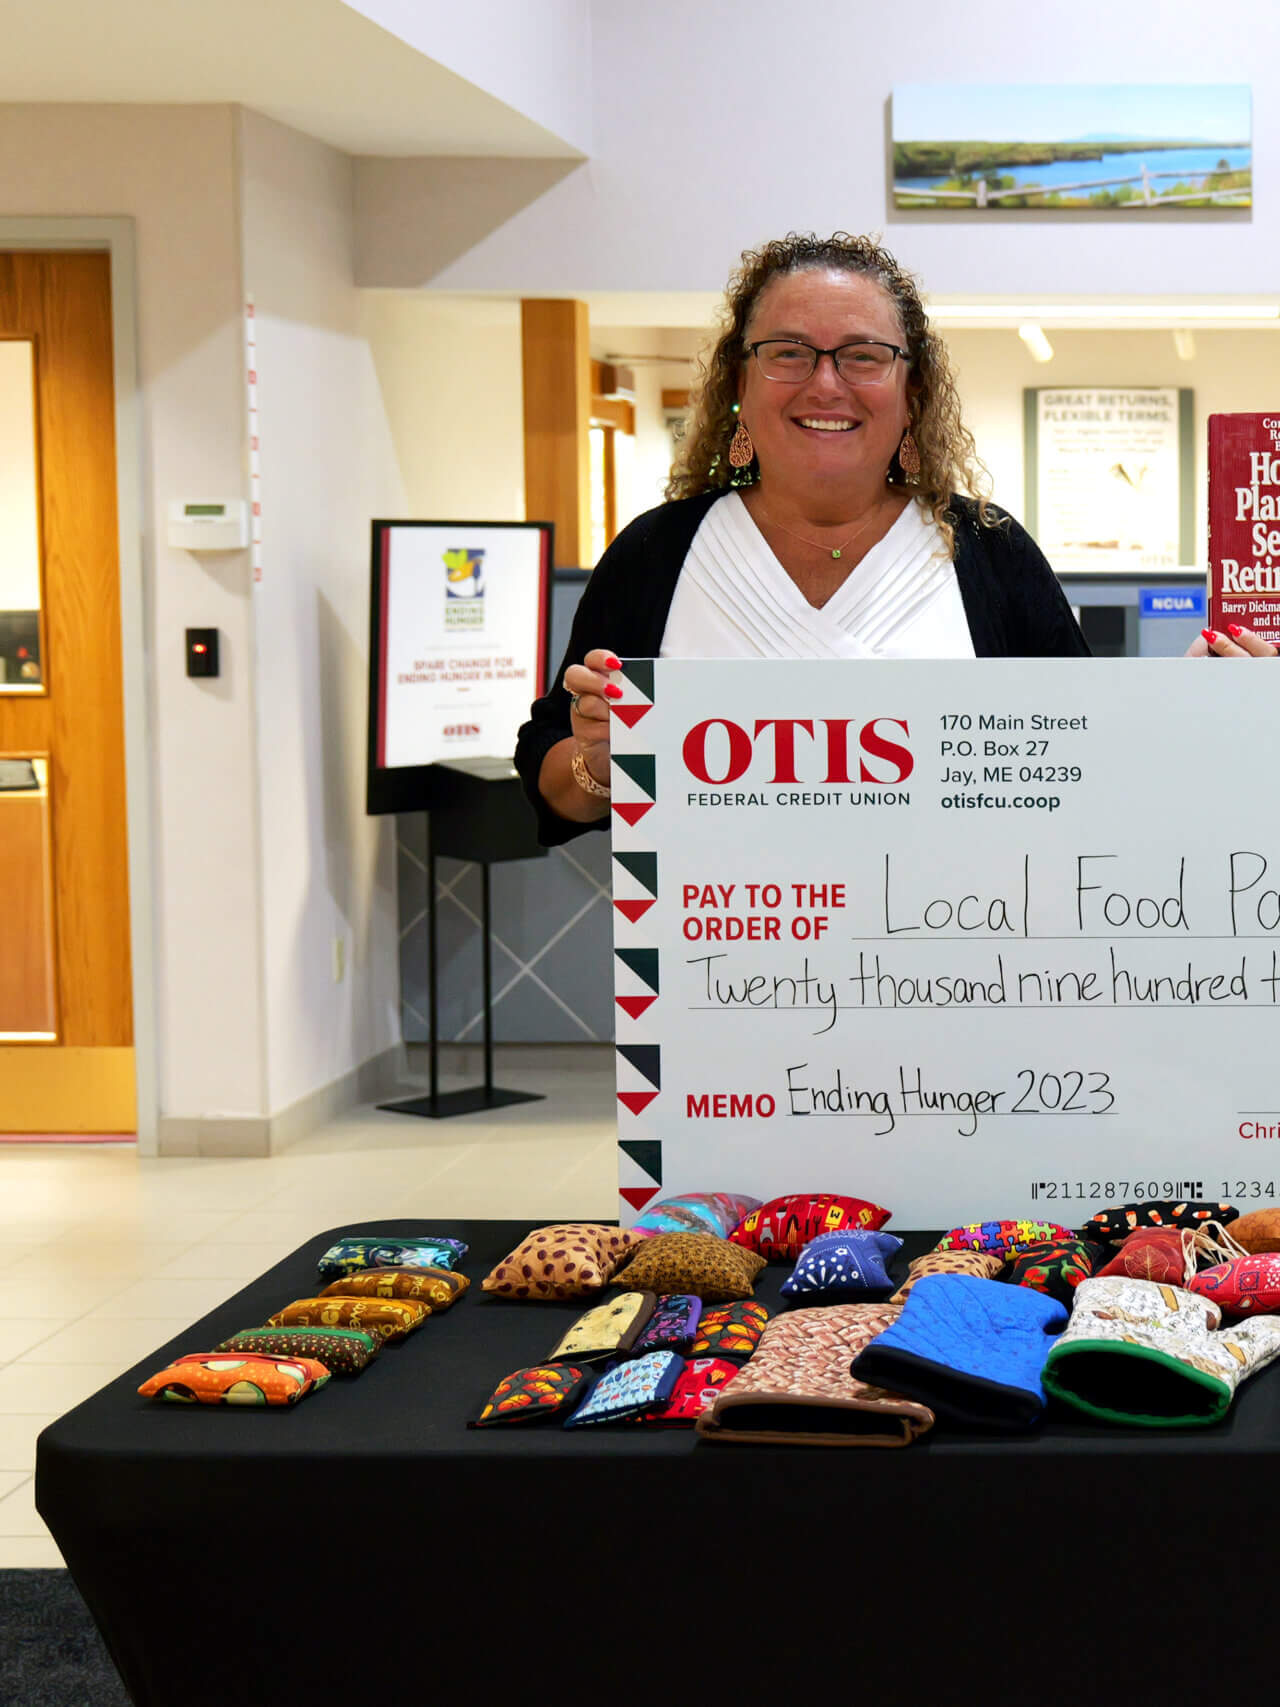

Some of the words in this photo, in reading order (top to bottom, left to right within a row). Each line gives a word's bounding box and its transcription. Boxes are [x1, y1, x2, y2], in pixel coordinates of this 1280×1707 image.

[1152, 598, 1194, 610] NCUA
[1222, 602, 1247, 615] Barry
[1253, 615, 1271, 626] and
[940, 714, 972, 731] 170
[979, 714, 1024, 731] Main
[1031, 714, 1088, 731] Street
[682, 717, 914, 785] OTIS
[940, 740, 977, 758] P.O.
[984, 740, 1020, 757] Box
[1025, 740, 1050, 757] 27
[940, 767, 977, 786] Jay,
[983, 766, 1013, 783] ME
[1019, 766, 1083, 784] 04239
[687, 793, 769, 807] FEDERAL
[776, 792, 843, 807] CREDIT
[849, 792, 911, 806] UNION
[940, 793, 1061, 812] otisfcu.coop
[682, 885, 736, 909] PAY
[744, 885, 782, 909] TO
[791, 884, 846, 909] THE
[886, 854, 1029, 937] Local
[1077, 854, 1190, 931] Food
[682, 917, 781, 941] ORDER
[790, 917, 828, 940] OF
[686, 953, 838, 1035] Twenty
[849, 951, 1006, 1007] thousand
[1018, 967, 1103, 1005] nine
[1110, 947, 1248, 1005] hundred
[686, 1094, 776, 1118] MEMO
[785, 1063, 895, 1136] Ending
[899, 1066, 1007, 1137] Hunger
[1010, 1069, 1116, 1114] 2023
